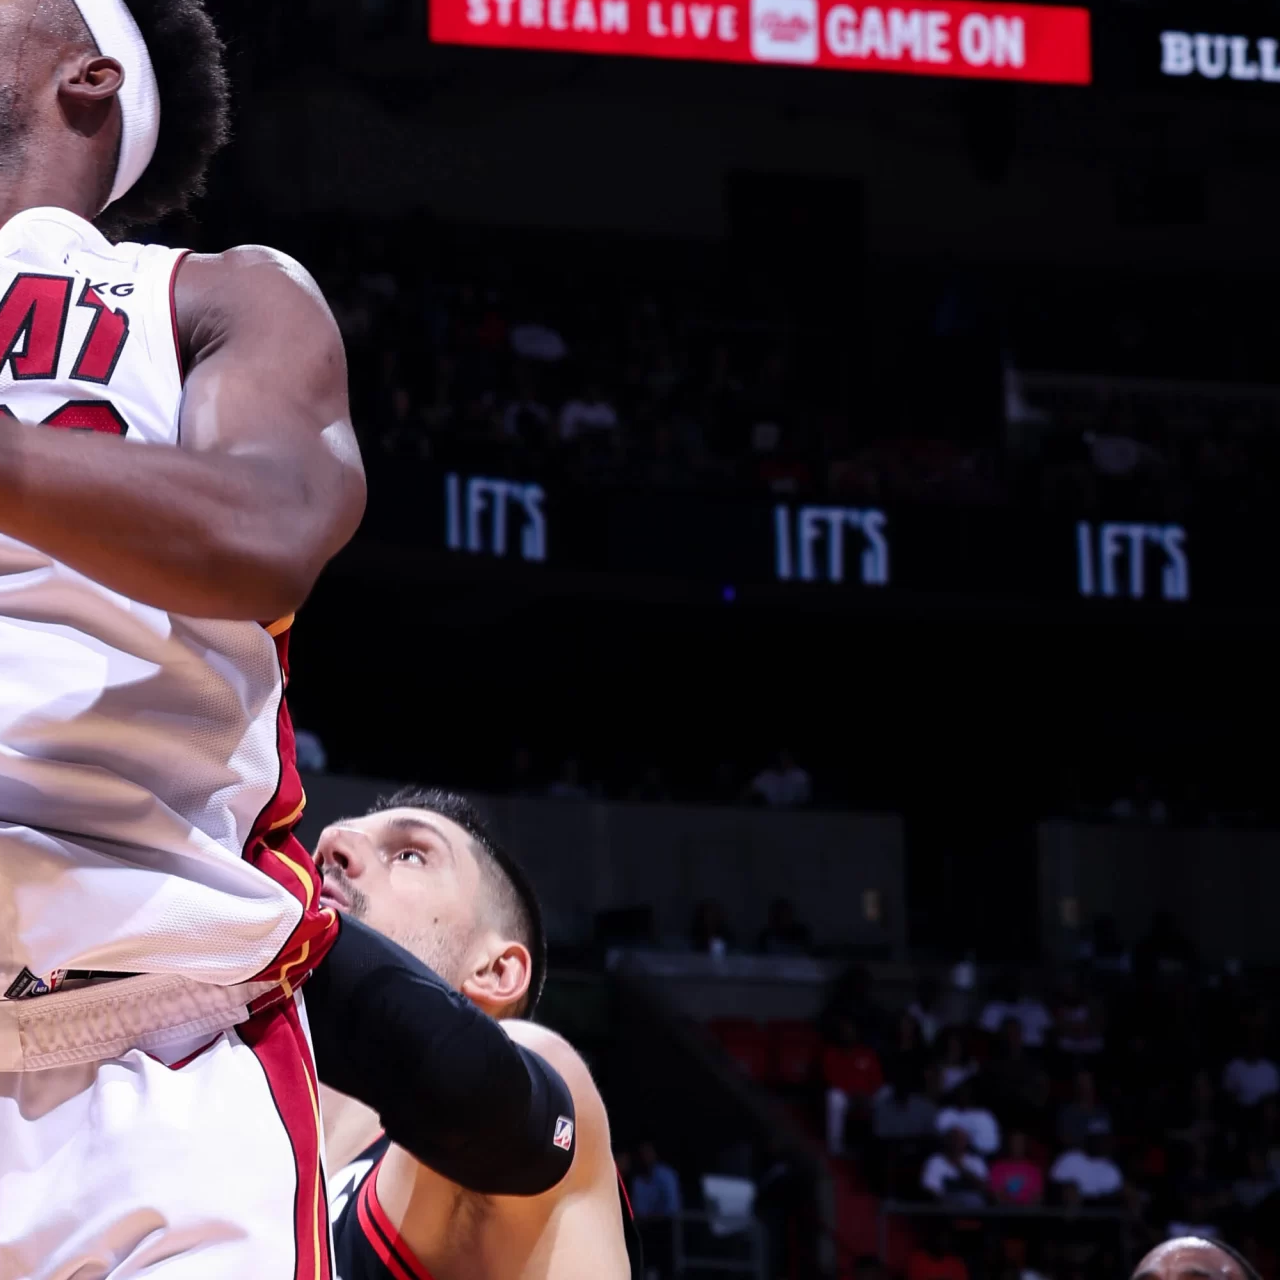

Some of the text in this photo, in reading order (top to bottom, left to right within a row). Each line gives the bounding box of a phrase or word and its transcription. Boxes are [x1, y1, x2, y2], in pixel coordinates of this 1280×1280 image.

[647, 0, 738, 42] LIVE
[825, 4, 952, 65] GAME
[957, 12, 1025, 69] ON
